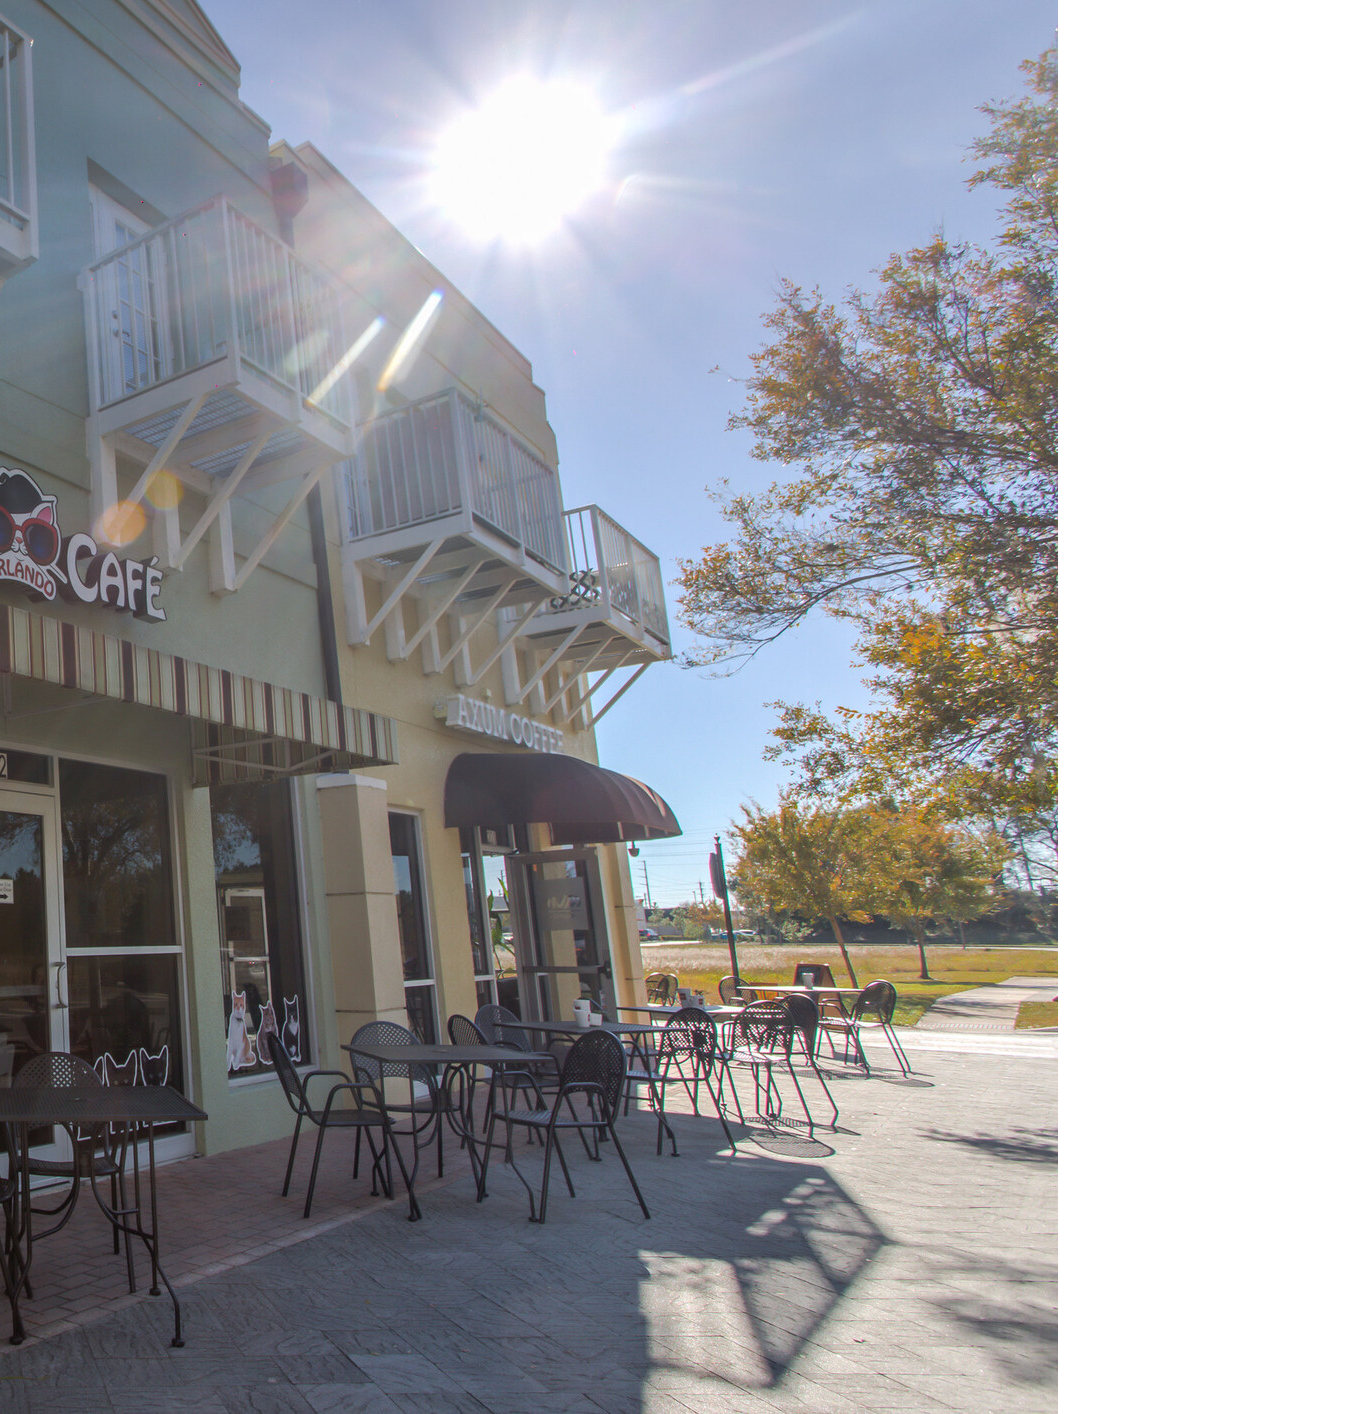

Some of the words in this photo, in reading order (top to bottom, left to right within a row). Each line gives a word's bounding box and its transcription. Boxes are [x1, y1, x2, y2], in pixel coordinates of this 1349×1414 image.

[66, 533, 167, 621] CAFÉ
[457, 694, 509, 741] AXUM
[510, 713, 563, 754] COFFEE
